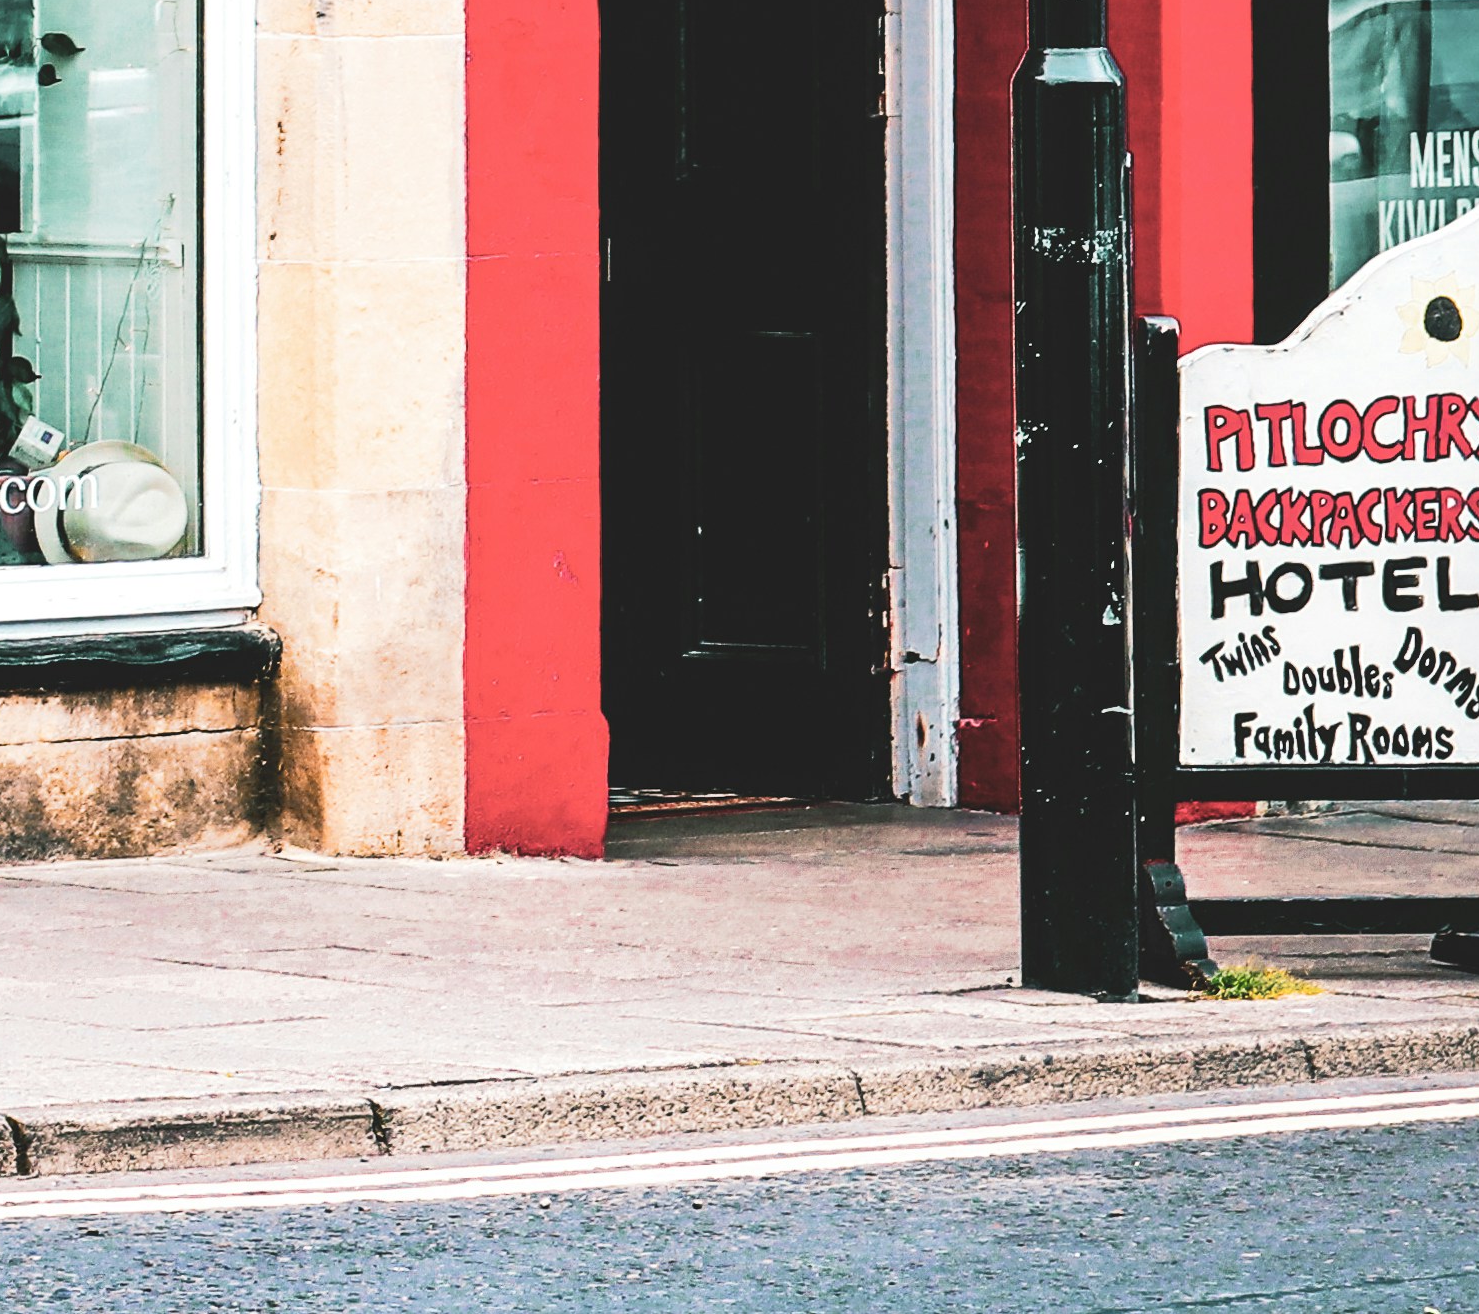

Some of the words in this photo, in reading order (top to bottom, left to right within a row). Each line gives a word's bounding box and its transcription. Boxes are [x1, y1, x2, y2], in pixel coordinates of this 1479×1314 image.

[1198, 625, 1283, 683] Twins
[1282, 645, 1395, 698] Doubles
[1233, 704, 1340, 763] Family
[1345, 712, 1455, 763] Rooms
